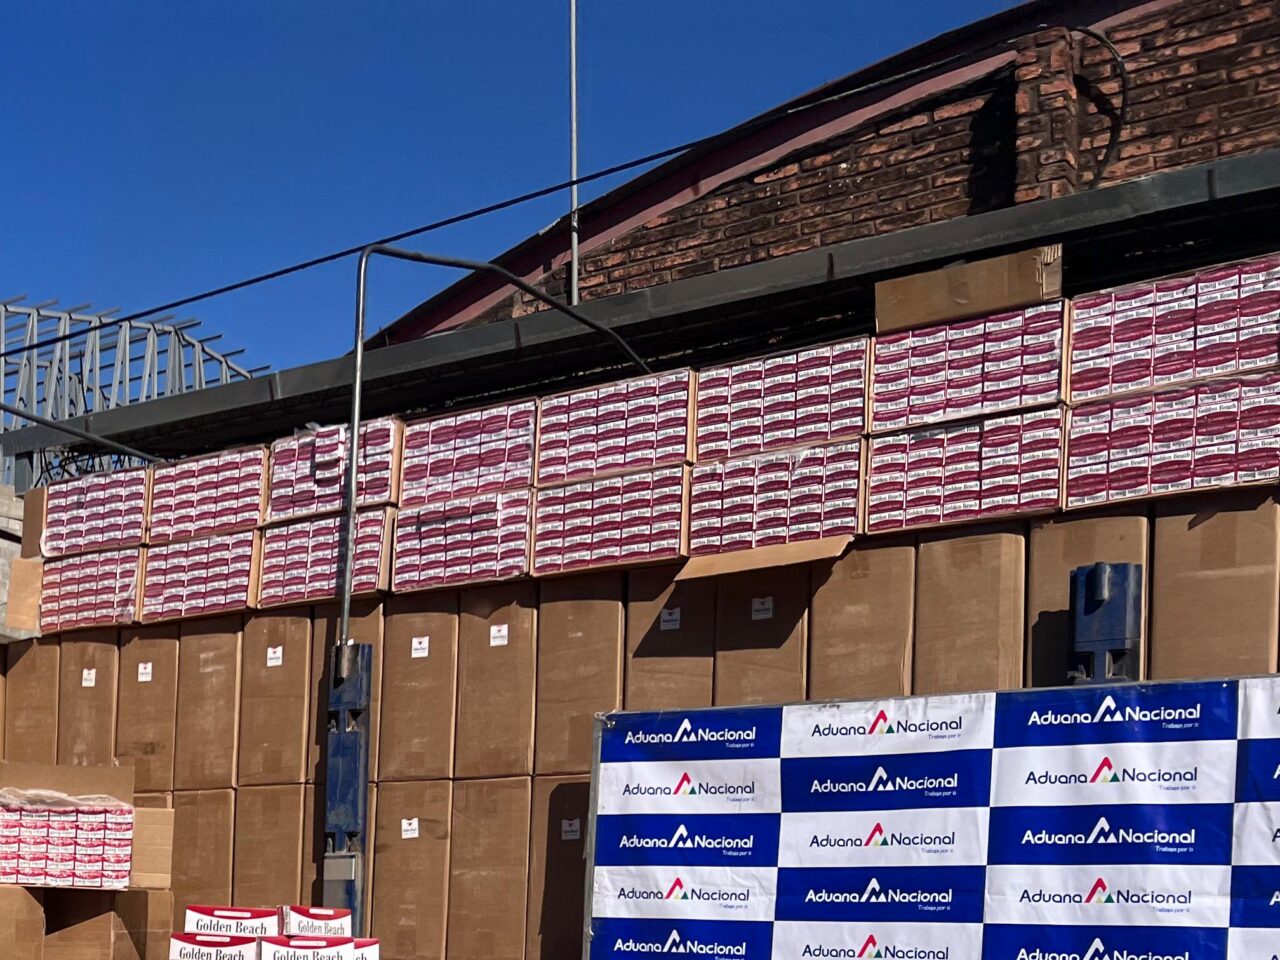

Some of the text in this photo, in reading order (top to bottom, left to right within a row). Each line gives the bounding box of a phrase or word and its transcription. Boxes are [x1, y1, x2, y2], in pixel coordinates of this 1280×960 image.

[1028, 704, 1200, 725] Aduana Nacional
[811, 717, 962, 737] Aduana Nacional
[625, 727, 756, 744] Aduana Nacional
[811, 773, 958, 792] Aduana Nacional
[1025, 767, 1197, 784] Aduana Nacional
[623, 782, 754, 796] Aduana Nacional
[620, 835, 753, 848] Aduana Nacional
[810, 832, 955, 847] Aduana Nacional
[1022, 829, 1195, 844] Aduana Nacional
[618, 888, 749, 901] Aduana Nacional
[805, 889, 952, 903] Aduana Nacional
[1019, 890, 1191, 904] Aduana Nacional
[196, 919, 267, 935] Golden Beach
[298, 921, 344, 935] Golden Beach
[179, 947, 212, 960] Golden
[614, 939, 746, 955] Aduana Nacional
[802, 944, 948, 960] Aduana Nacional
